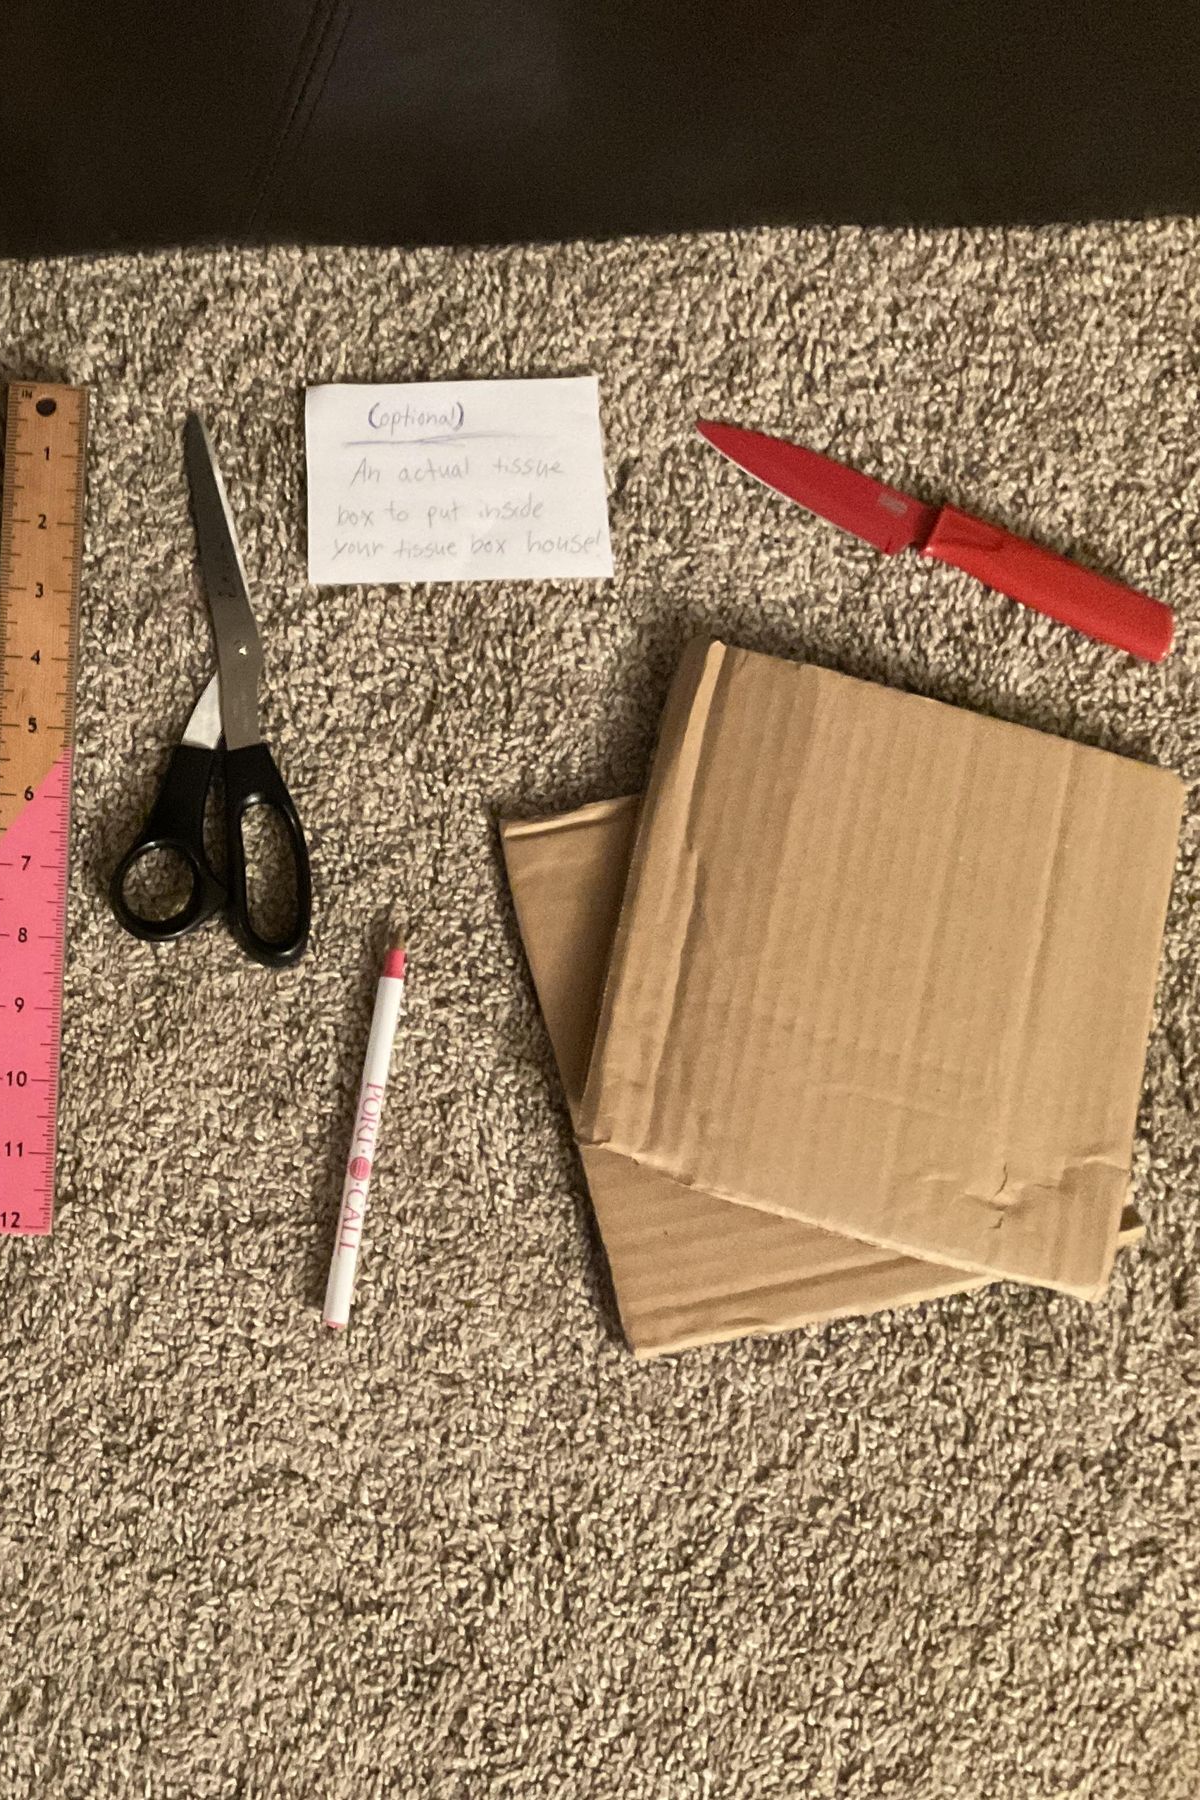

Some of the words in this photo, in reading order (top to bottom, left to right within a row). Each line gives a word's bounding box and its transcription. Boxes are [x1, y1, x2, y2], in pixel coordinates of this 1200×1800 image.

[22, 388, 33, 399] IN
[367, 401, 464, 436] (optional)
[43, 446, 51, 461] 1
[350, 457, 381, 486] An
[399, 456, 469, 482] actual
[493, 456, 565, 478] tissue
[338, 504, 375, 528] box
[384, 500, 409, 522] to
[427, 501, 463, 528] put
[479, 491, 544, 520] inside
[38, 514, 47, 529] 2
[331, 538, 384, 561] your
[393, 538, 458, 560] tissue
[471, 533, 506, 554] box
[35, 582, 44, 598] 3
[30, 649, 41, 665] 4
[28, 718, 37, 733] 5
[24, 786, 34, 801] 6
[21, 856, 32, 871] 7
[18, 927, 28, 943] 8
[14, 997, 25, 1013] 9
[6, 1071, 28, 1087] 10
[4, 1142, 24, 1157] 11
[0, 1212, 21, 1228] 12
[337, 1188, 365, 1257] CALL
